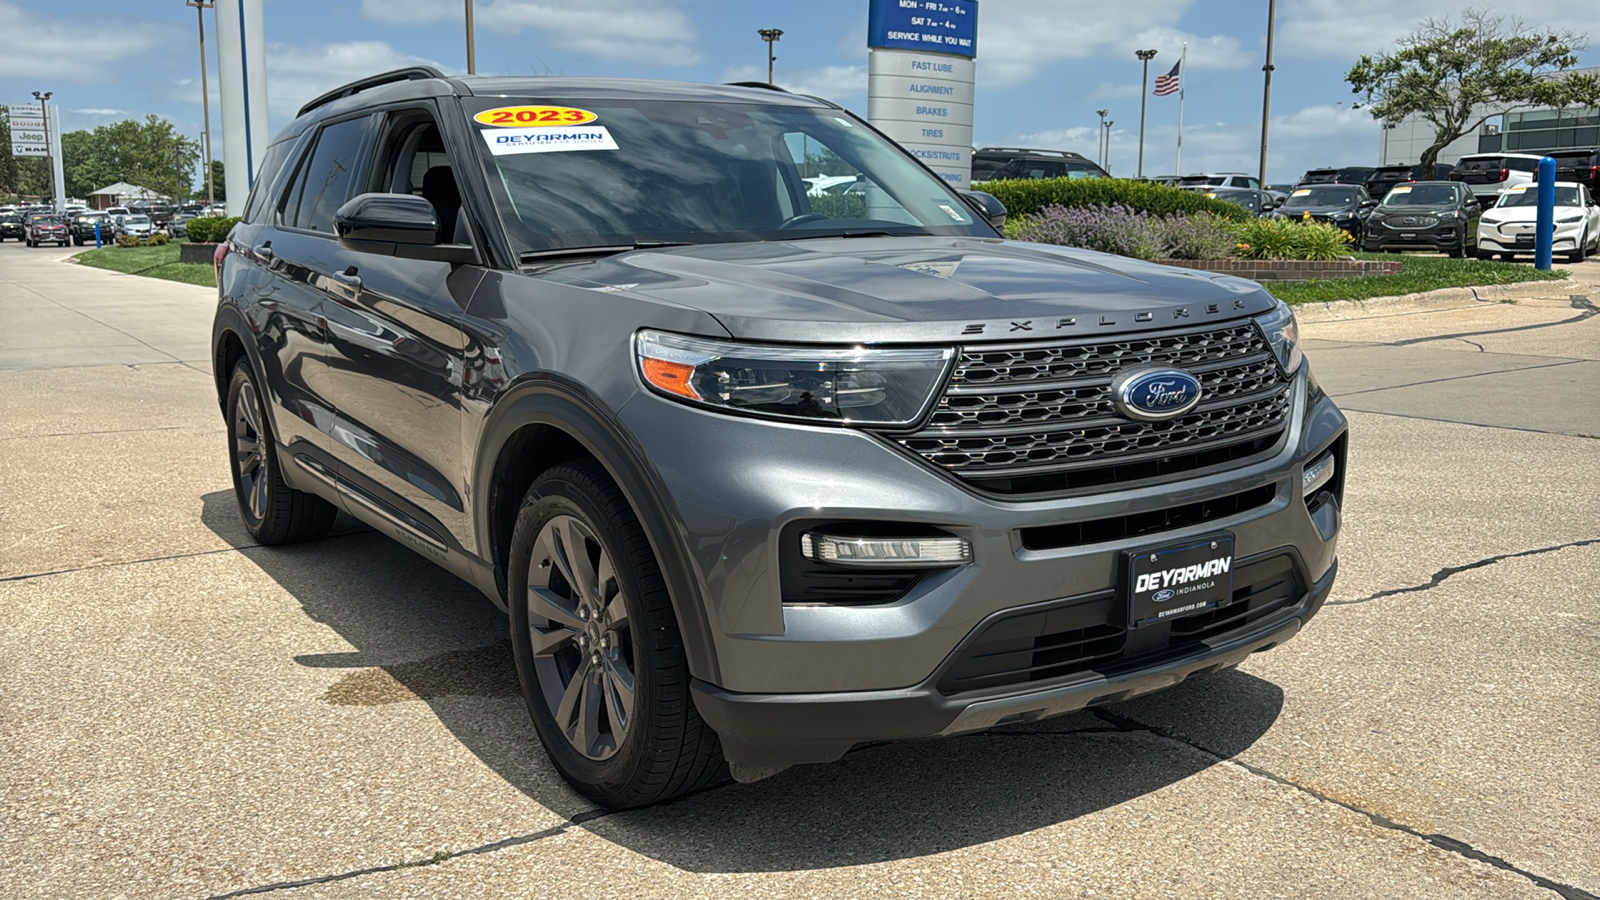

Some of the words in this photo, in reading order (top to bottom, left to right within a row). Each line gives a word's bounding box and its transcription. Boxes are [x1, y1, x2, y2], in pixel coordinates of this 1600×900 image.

[899, 0, 917, 8] MON
[925, 2, 937, 11] FRI
[911, 16, 925, 26] SAT
[887, 31, 920, 41] SERVICE
[921, 33, 943, 44] WHILE
[944, 36, 958, 46] YOU
[958, 38, 972, 47] WAIT
[911, 61, 932, 71] FAST
[933, 63, 953, 73] LUBE
[909, 84, 954, 95] ALIGNMENT
[491, 110, 586, 124] 2023
[916, 107, 948, 117] BRAKES
[19, 132, 43, 142] Jeep
[496, 133, 603, 144] DEYARMAN
[921, 128, 943, 138] TIRES
[910, 149, 960, 161] OCKS/STRUTS
[961, 300, 1246, 335] EXPLORER
[1146, 380, 1187, 407] Ford
[1135, 556, 1232, 593] DEYARMAN
[1176, 581, 1215, 596] INDIANOLA
[1158, 601, 1207, 618] DEYARMANFORD.COM
